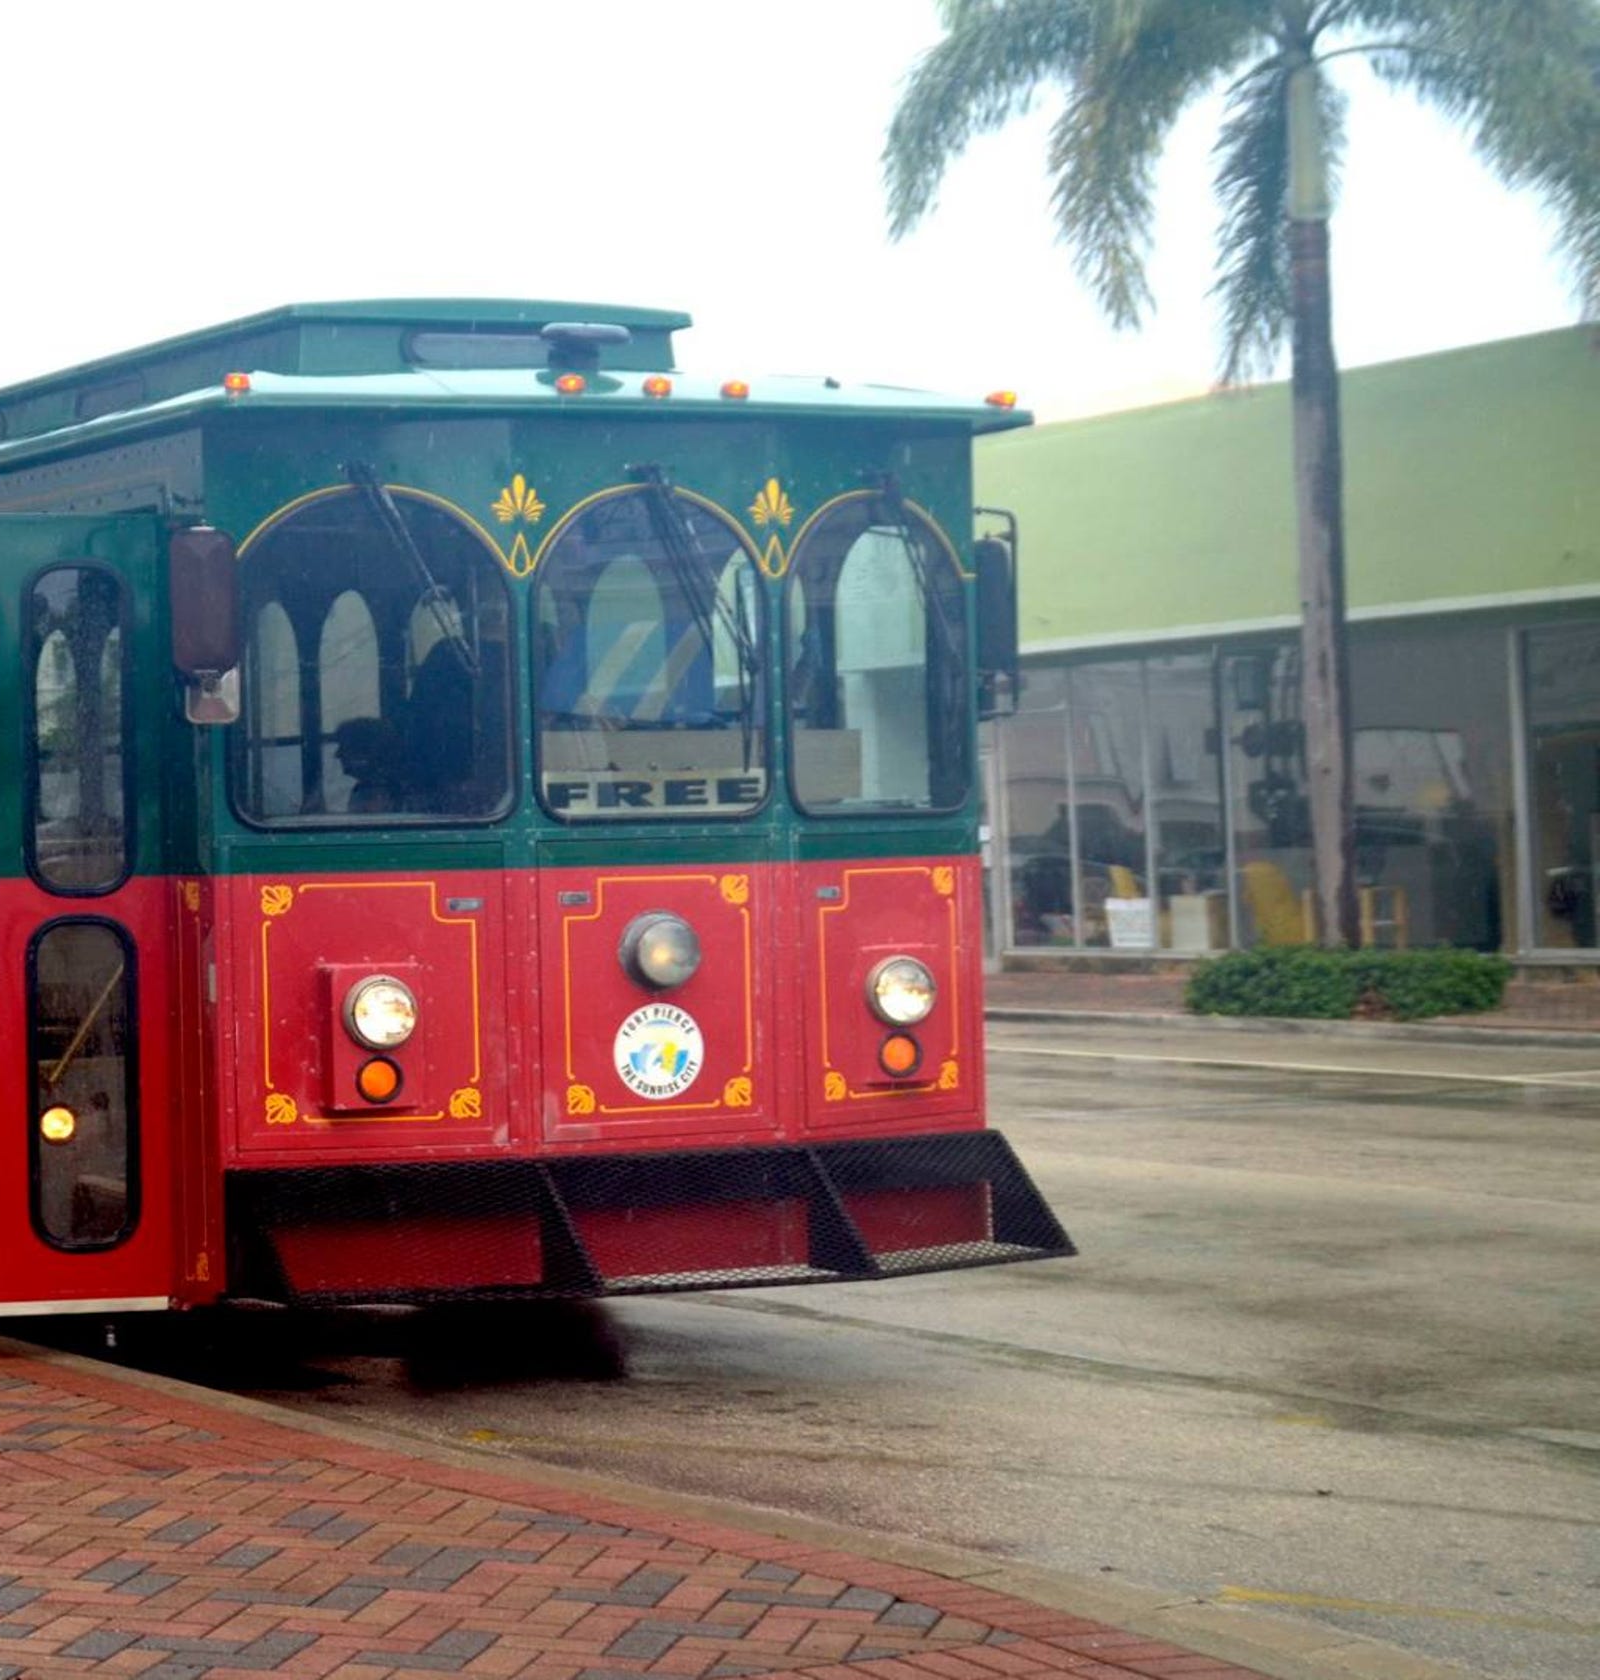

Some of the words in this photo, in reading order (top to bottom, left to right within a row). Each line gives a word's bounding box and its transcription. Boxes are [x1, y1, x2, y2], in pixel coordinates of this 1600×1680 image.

[546, 777, 761, 809] FREE
[622, 1010, 649, 1038] FORT
[653, 1007, 696, 1035] PIERCE
[621, 1063, 637, 1083] THE
[636, 1080, 680, 1096] SUNRISE
[680, 1060, 698, 1083] CITY
